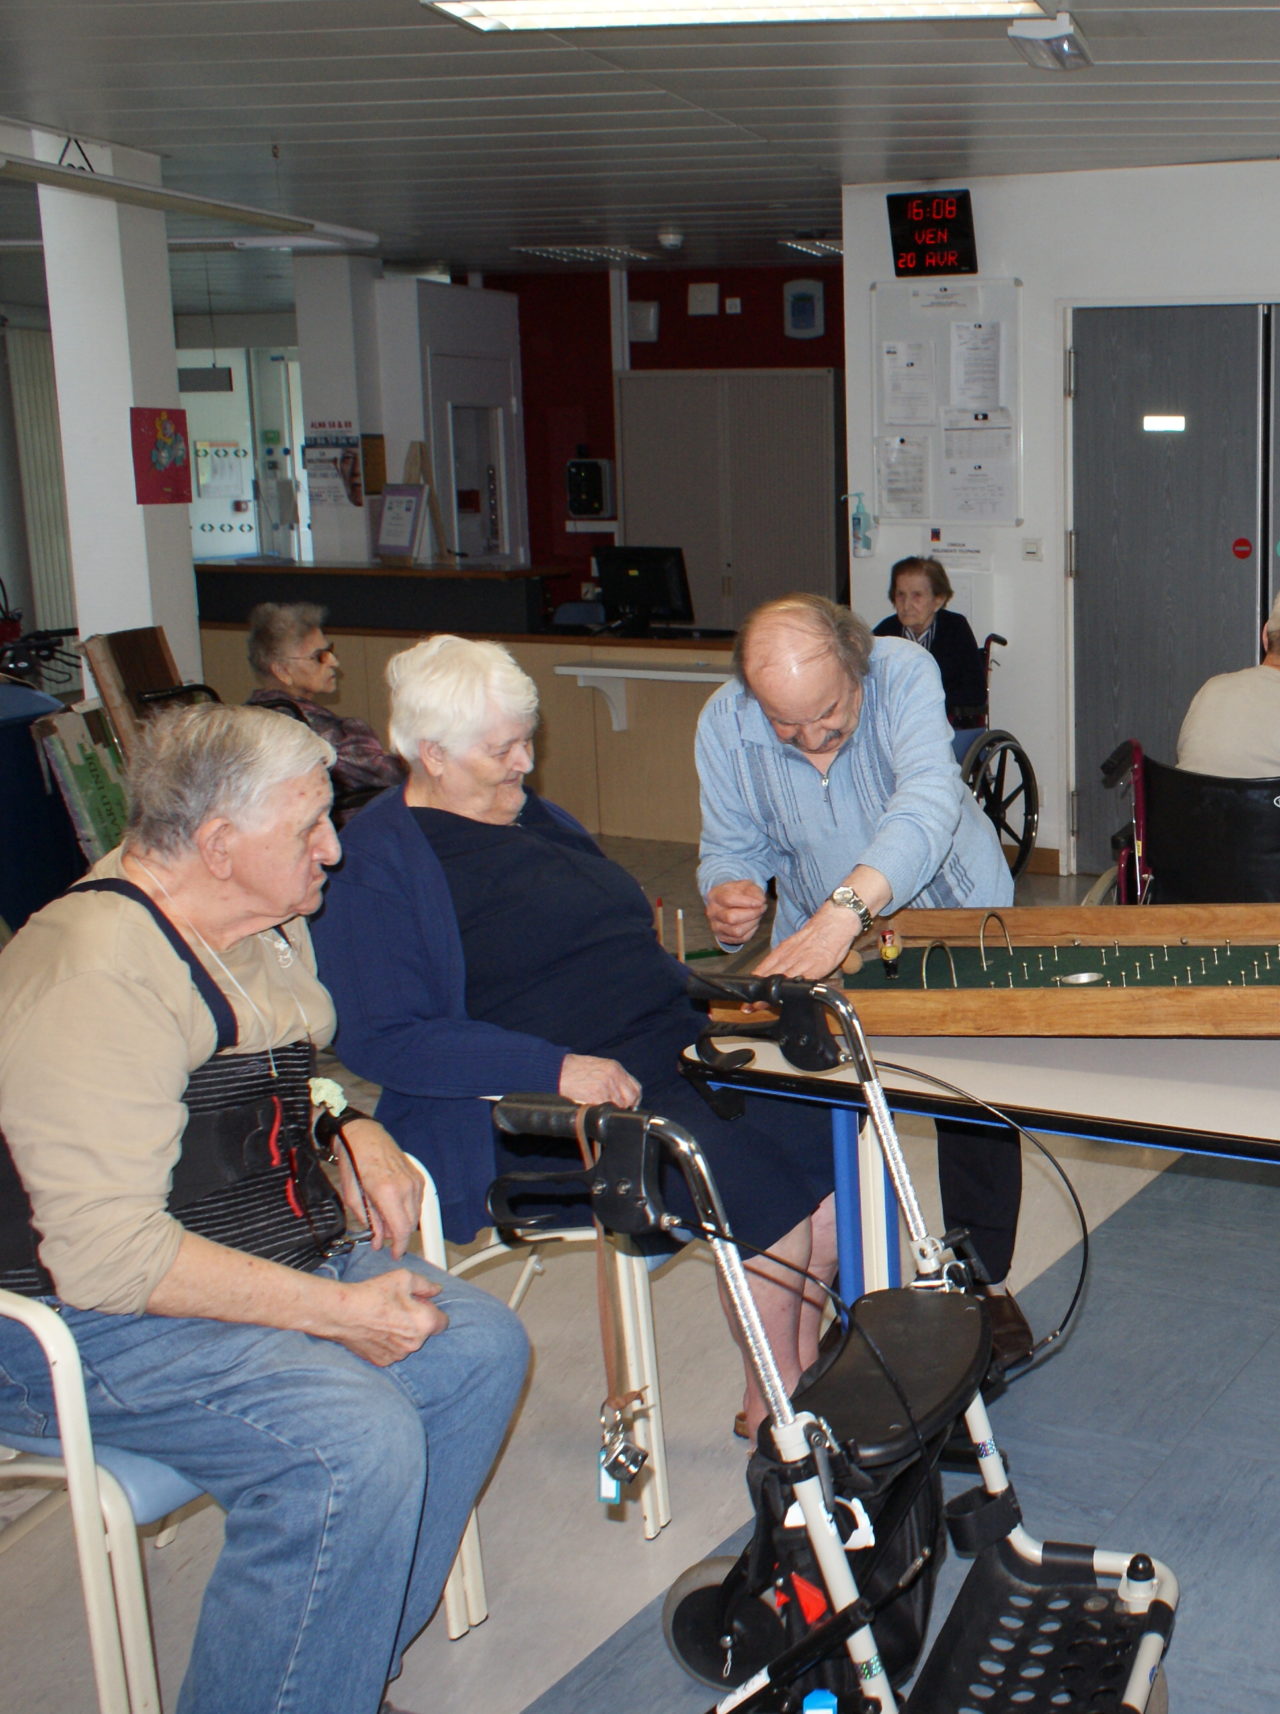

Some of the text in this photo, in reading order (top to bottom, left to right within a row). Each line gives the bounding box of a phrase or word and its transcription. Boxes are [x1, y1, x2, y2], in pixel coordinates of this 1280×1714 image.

[907, 197, 957, 221] 16:08
[914, 227, 948, 245] VEN
[897, 250, 959, 268] 20 AVR
